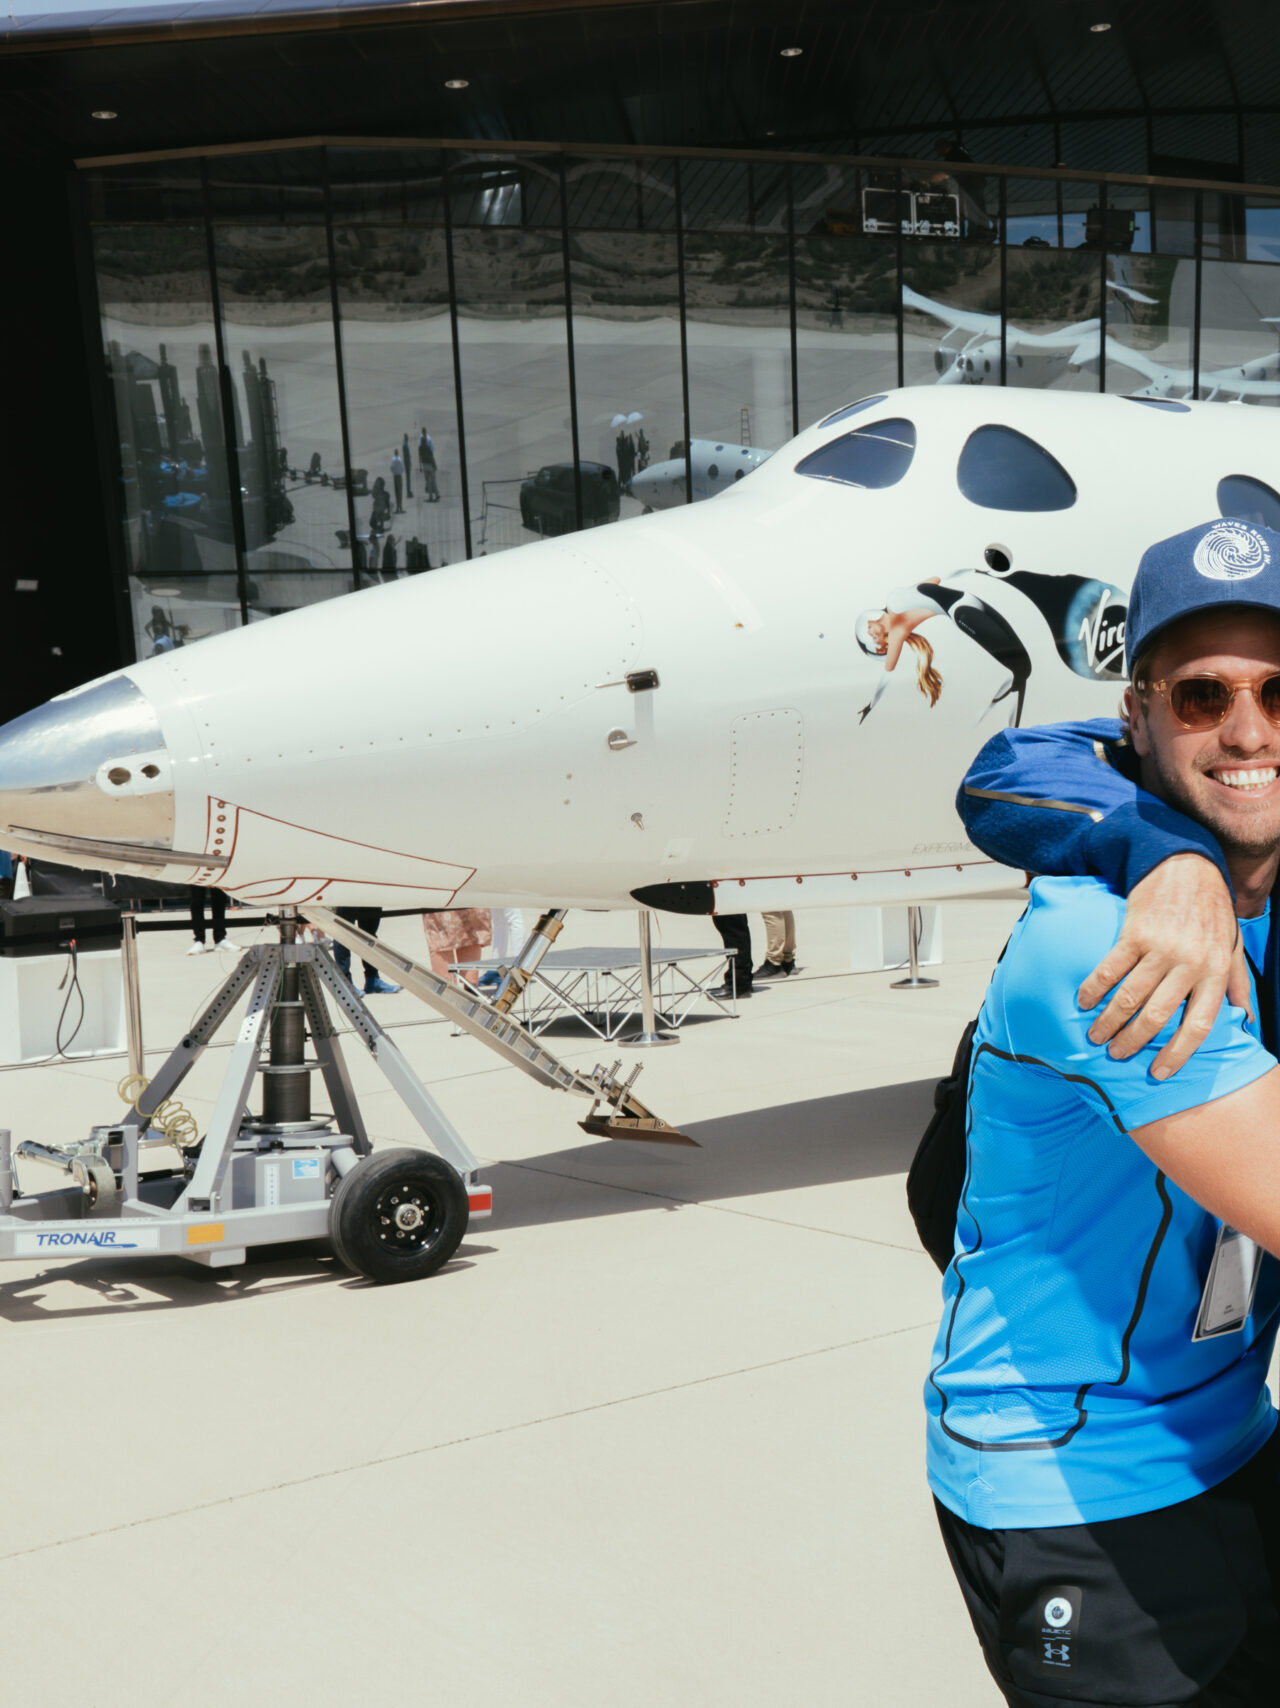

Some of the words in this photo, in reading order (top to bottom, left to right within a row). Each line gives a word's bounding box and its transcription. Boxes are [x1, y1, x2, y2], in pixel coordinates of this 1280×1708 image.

[1211, 521, 1248, 531] WAVES
[1250, 529, 1270, 552] RUSH
[1263, 553, 1272, 565] IN
[36, 1231, 117, 1248] TRONAIR
